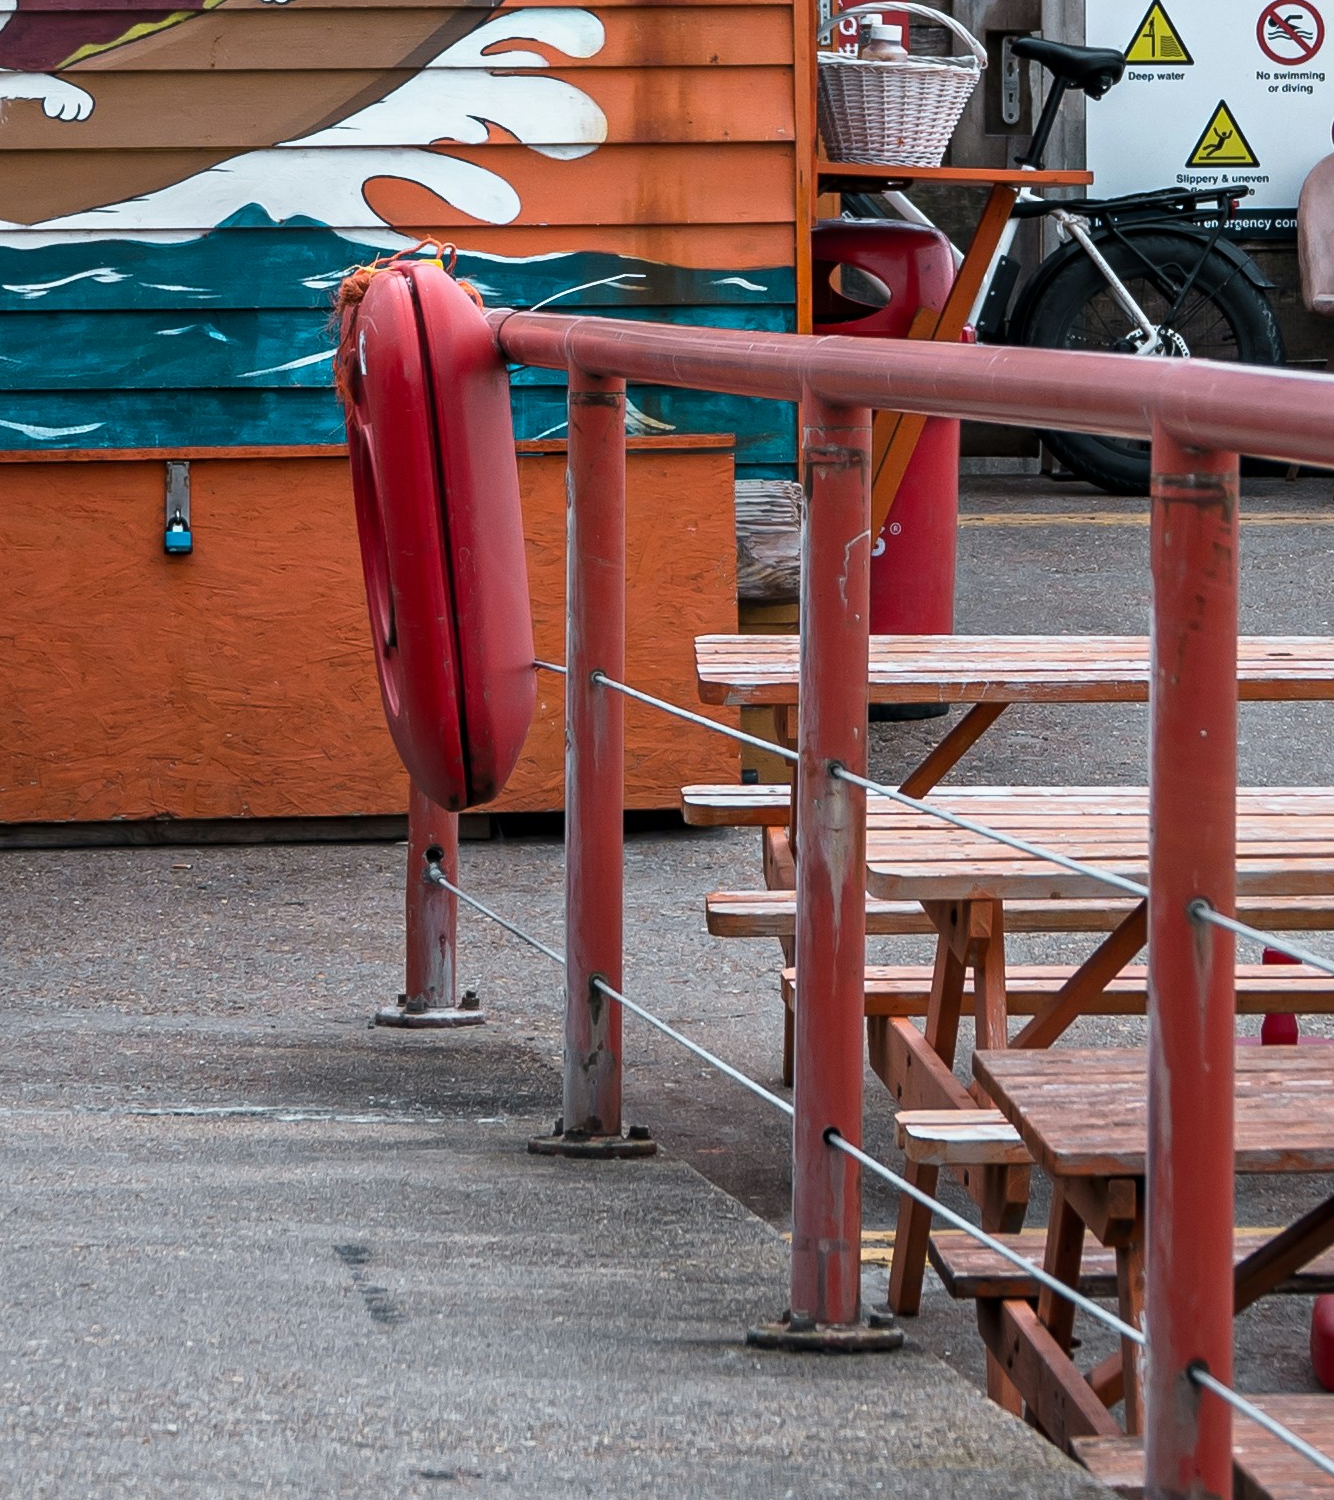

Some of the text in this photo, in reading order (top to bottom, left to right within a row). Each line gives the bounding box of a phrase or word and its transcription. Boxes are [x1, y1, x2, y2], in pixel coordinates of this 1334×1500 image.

[1128, 71, 1186, 83] Deep water
[1256, 70, 1326, 82] No swimming
[1267, 83, 1314, 95] or diving
[1176, 173, 1270, 186] Slippery & uneven
